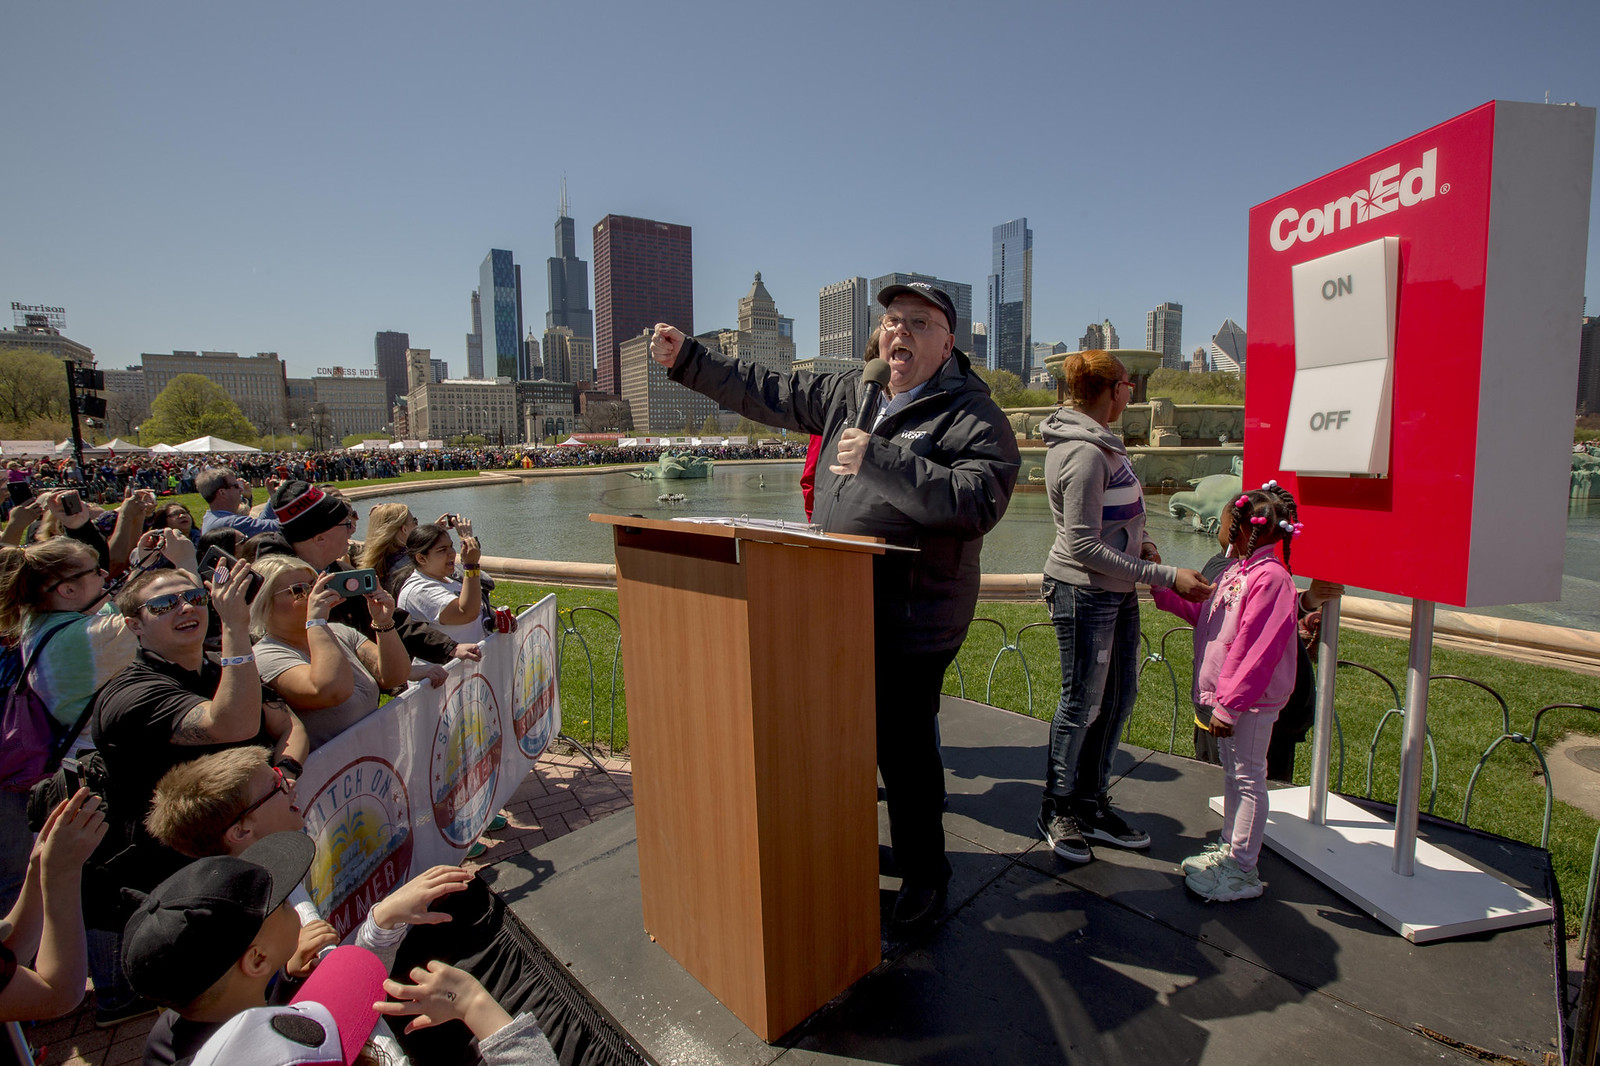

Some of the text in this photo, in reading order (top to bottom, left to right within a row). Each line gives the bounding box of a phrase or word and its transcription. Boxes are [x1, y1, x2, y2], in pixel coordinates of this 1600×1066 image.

[1270, 147, 1437, 252] ComEd
[1322, 274, 1352, 300] ON
[11, 302, 66, 313] Harrison
[316, 367, 357, 377] CONGRESS
[1309, 410, 1351, 432] OFF
[438, 683, 478, 745] SWITCH
[371, 769, 393, 799] ON
[446, 753, 494, 819] SUMMER
[333, 860, 397, 936] MMER
